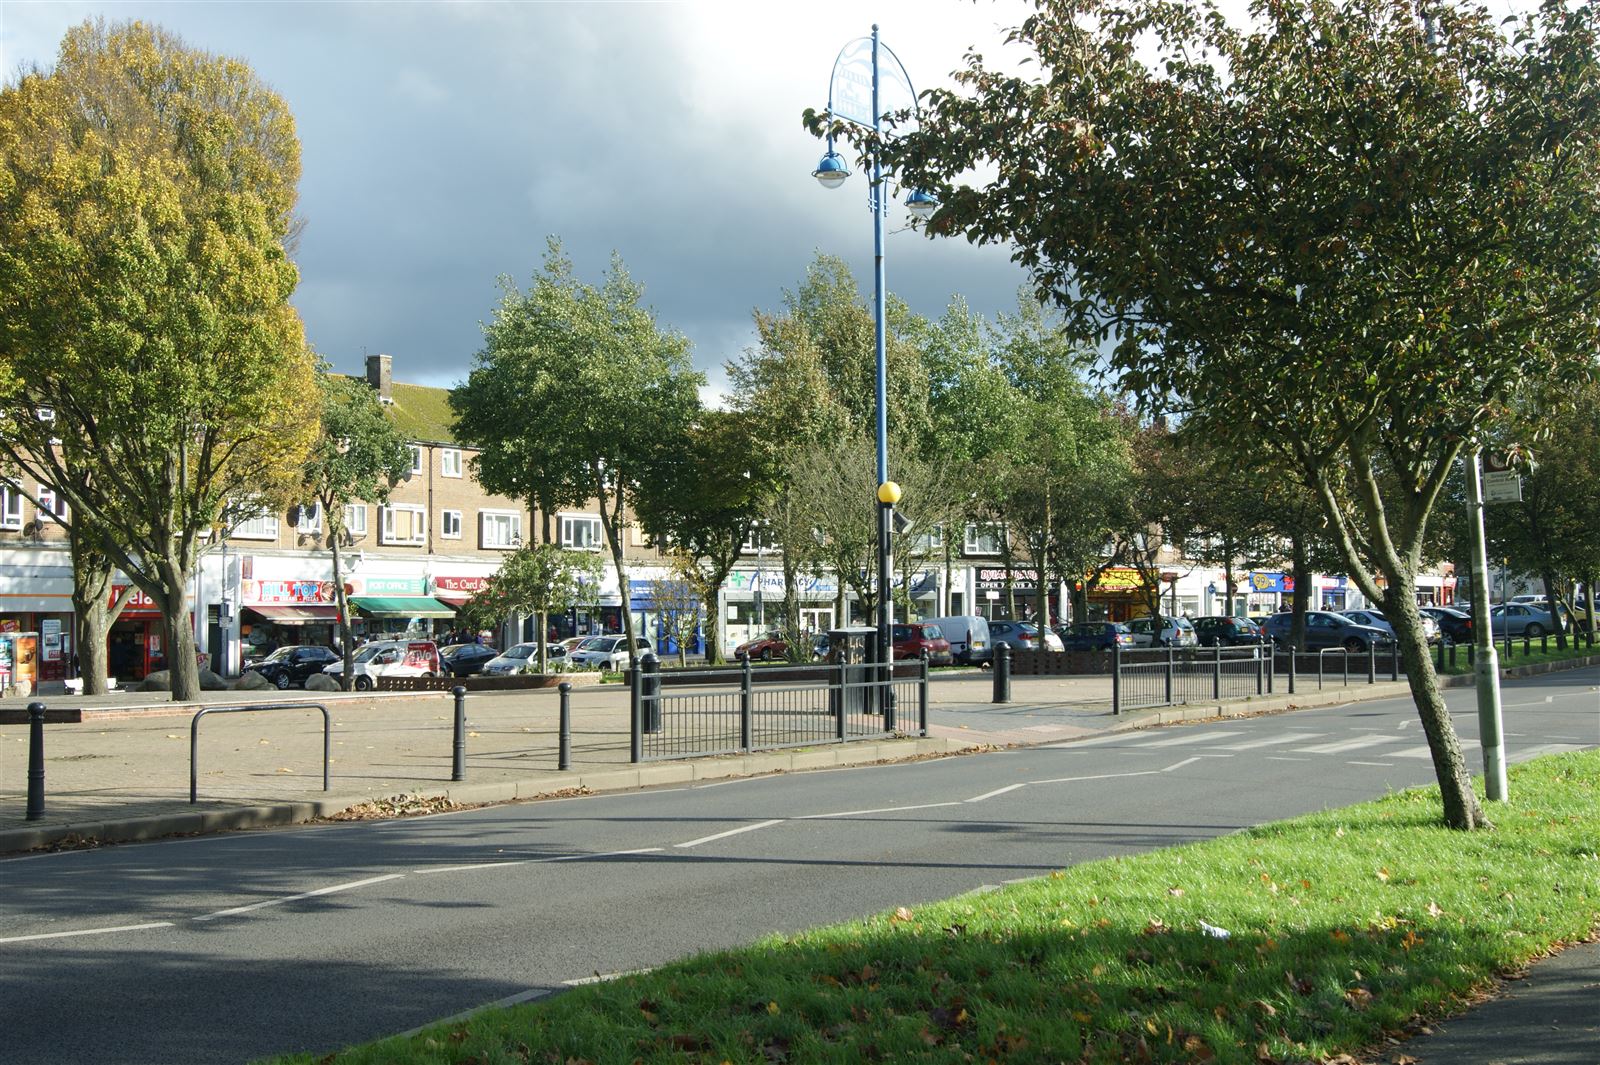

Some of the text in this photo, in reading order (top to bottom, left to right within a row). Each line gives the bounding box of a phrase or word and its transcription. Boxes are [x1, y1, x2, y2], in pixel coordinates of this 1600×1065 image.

[369, 581, 385, 589] POST
[386, 581, 408, 590] OFFICE
[445, 579, 458, 589] The
[460, 579, 477, 589] Card
[759, 578, 810, 586] PHARCY
[262, 582, 290, 596] HILL
[293, 582, 319, 597] TOP
